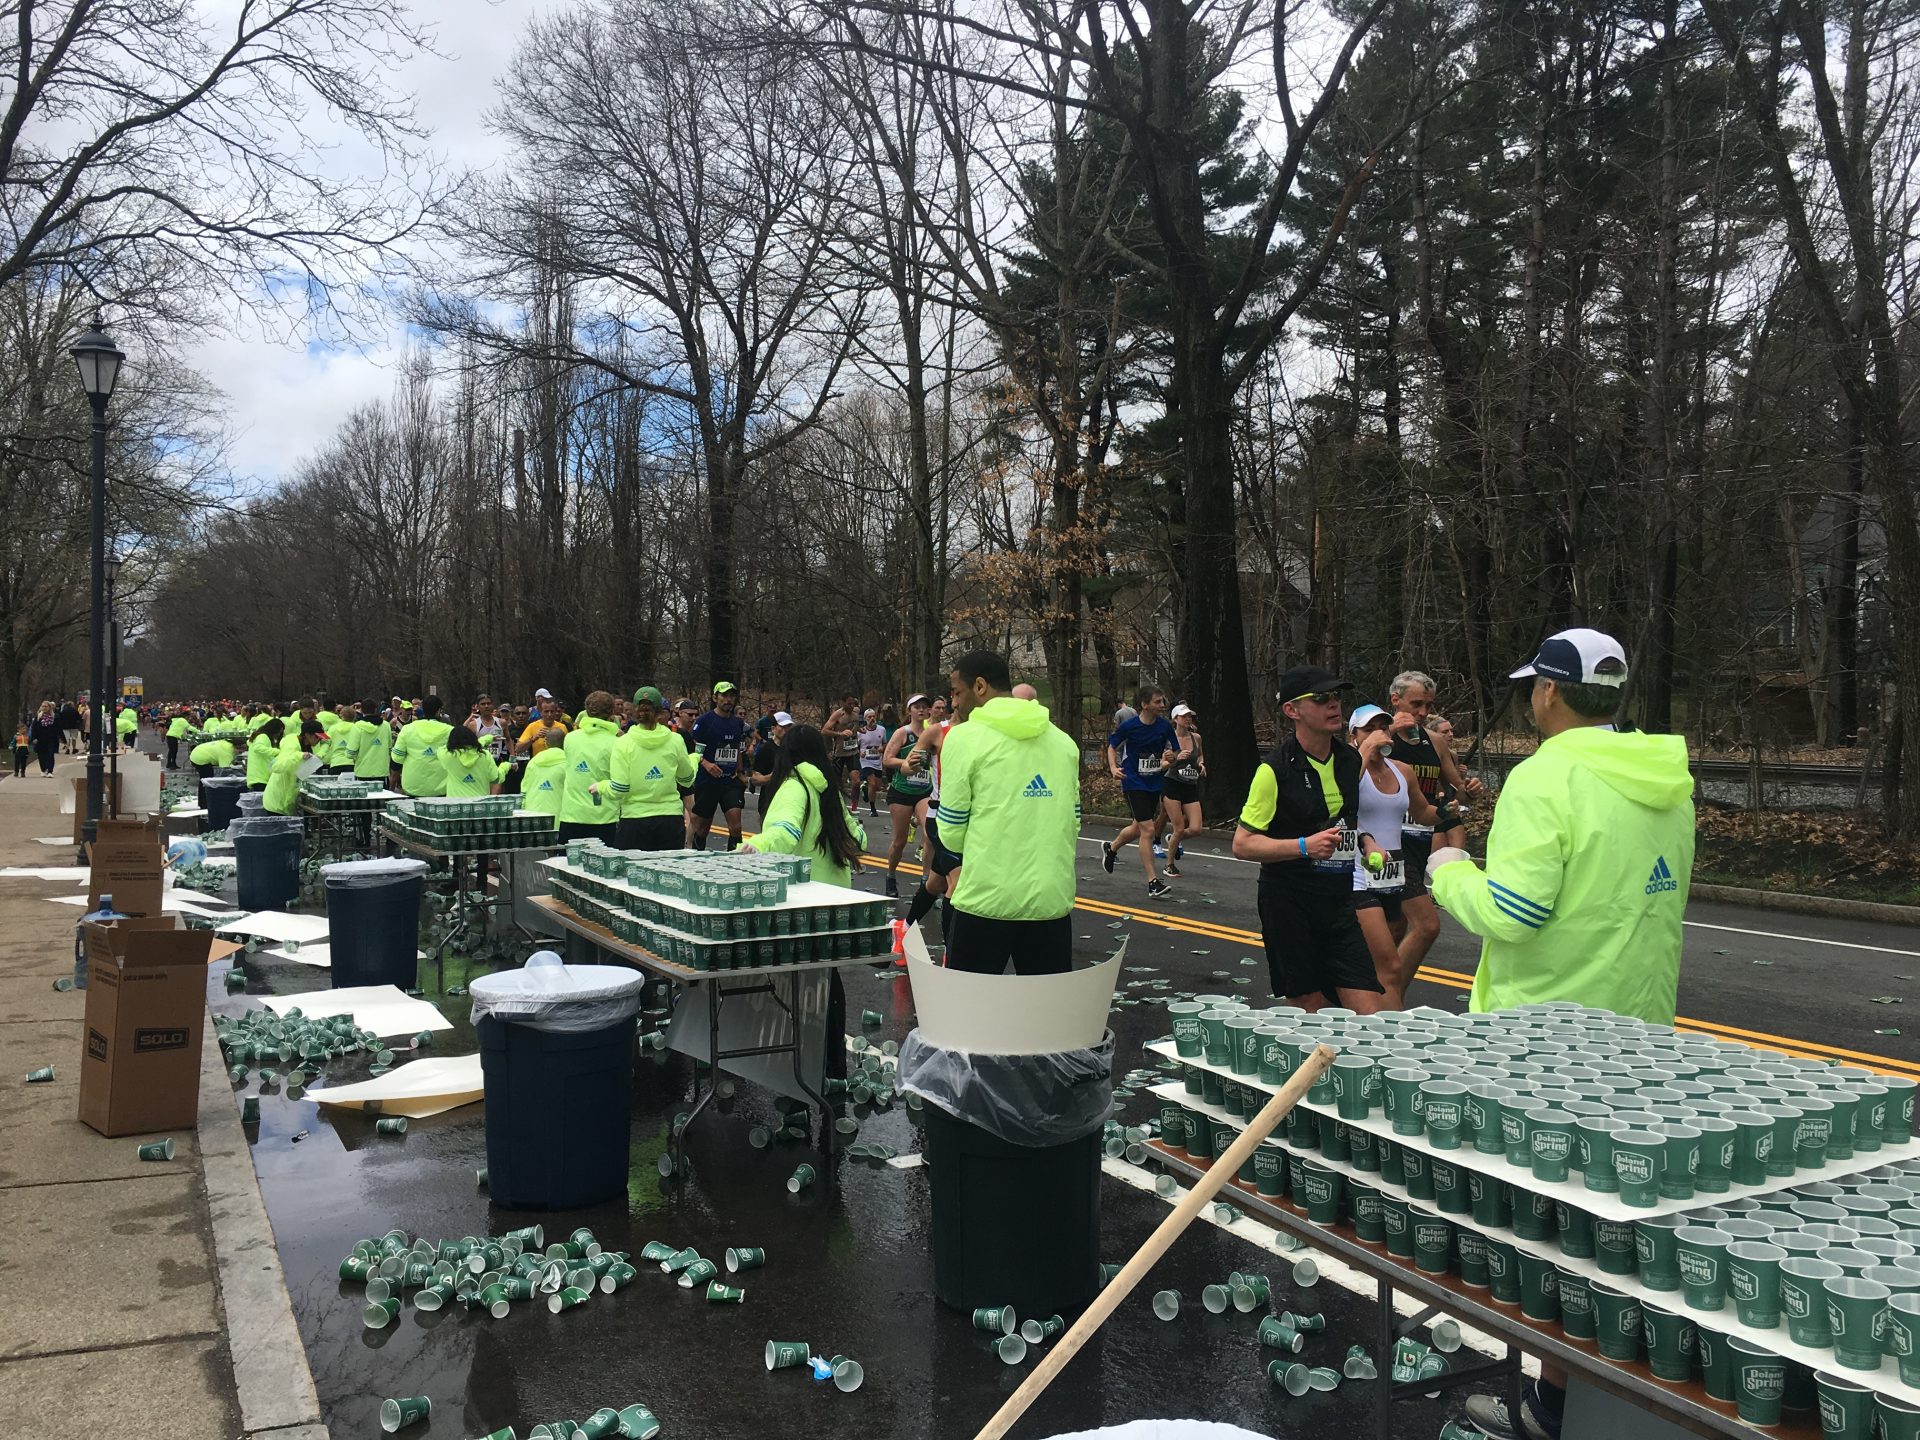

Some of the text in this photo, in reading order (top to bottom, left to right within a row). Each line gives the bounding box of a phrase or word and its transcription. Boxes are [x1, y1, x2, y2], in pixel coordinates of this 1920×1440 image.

[1022, 788, 1053, 797] adidas
[1645, 879, 1678, 895] adidas
[1175, 1027, 1200, 1037] Spring
[89, 1037, 105, 1054] SOLO
[140, 1033, 184, 1046] SOLO
[1428, 1104, 1456, 1113] Poland
[1163, 1115, 1184, 1125] Sprin
[1427, 1111, 1458, 1124] Spring
[1502, 1124, 1520, 1139] ring
[1800, 1122, 1828, 1131] Poland
[1536, 1133, 1566, 1143] Poland
[1534, 1140, 1568, 1155] Spring
[1616, 1154, 1646, 1167] Poland
[1616, 1161, 1649, 1179] Spring
[1433, 1173, 1452, 1188] ring
[1359, 1206, 1383, 1215] Sprin
[1420, 1227, 1447, 1236] Poland
[1601, 1223, 1632, 1233] Poland
[1418, 1234, 1448, 1246] Spring
[1599, 1231, 1634, 1244] Spring
[1732, 1277, 1754, 1296] ring
[1750, 1369, 1784, 1379] Poland
[1747, 1377, 1784, 1392] Spring
